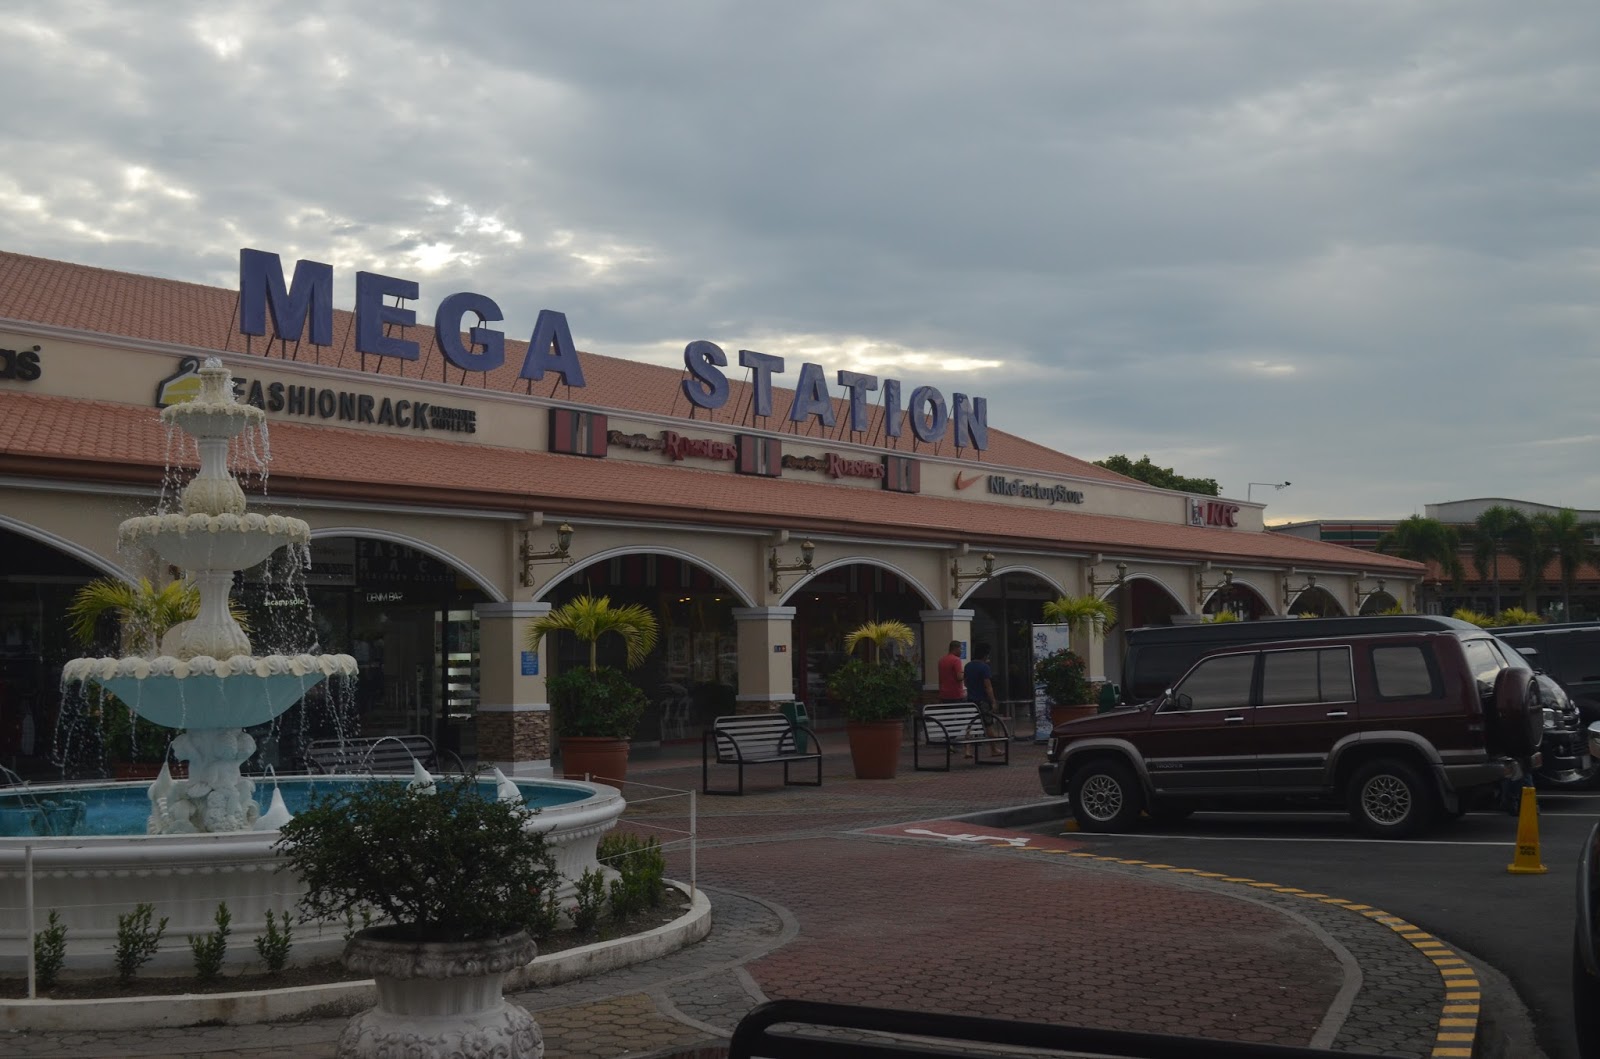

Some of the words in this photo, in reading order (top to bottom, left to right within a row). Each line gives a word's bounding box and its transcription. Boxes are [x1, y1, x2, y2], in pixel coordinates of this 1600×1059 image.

[240, 248, 586, 388] MEGA
[682, 340, 988, 451] STATION
[431, 406, 476, 422] DESIGNER
[432, 418, 476, 433] OUTLETS
[662, 430, 738, 461] Roasters
[826, 452, 885, 479] Roasters
[1207, 502, 1240, 527] KFC
